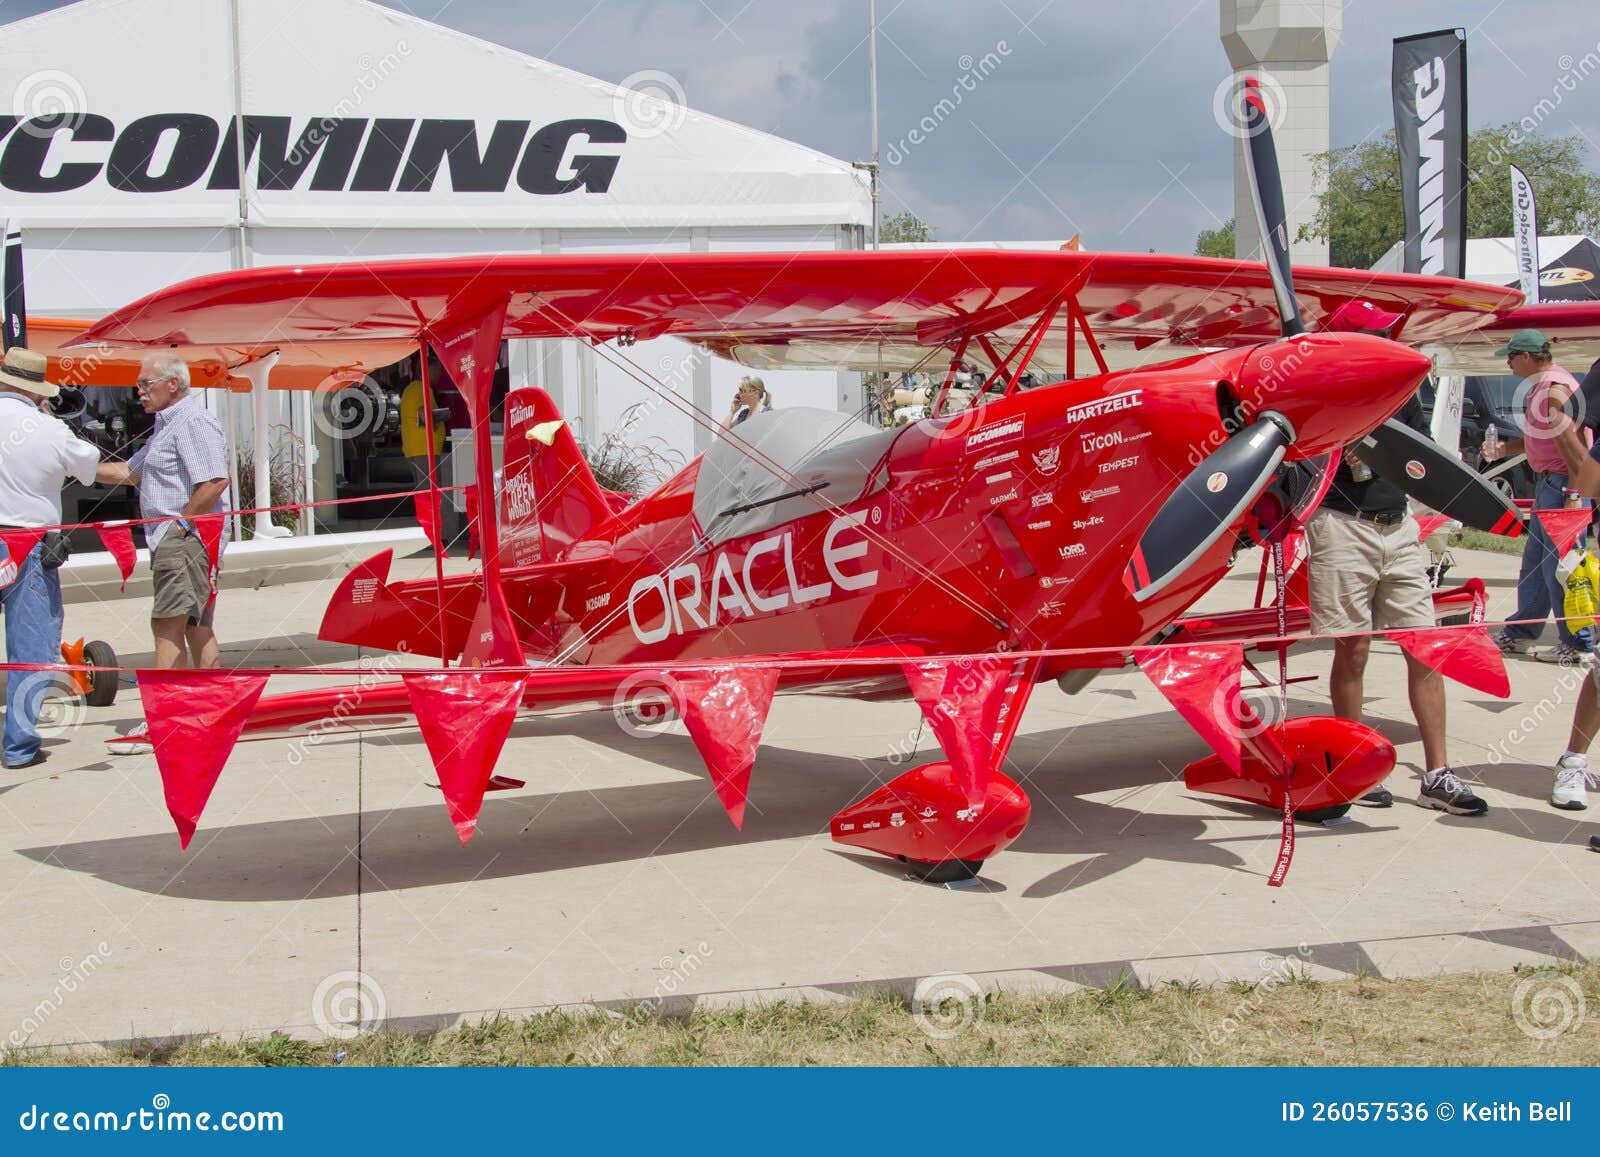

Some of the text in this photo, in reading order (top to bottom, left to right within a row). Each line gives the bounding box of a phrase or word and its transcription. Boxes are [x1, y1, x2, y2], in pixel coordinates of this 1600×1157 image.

[0, 113, 627, 195] COMING
[1067, 394, 1143, 424] HARTZELL
[967, 420, 1022, 446] LYCOMING
[1082, 431, 1123, 453] LYCON
[1098, 456, 1139, 473] TEMPEST
[990, 490, 1018, 505] GARMIN
[1059, 543, 1085, 556] LORD
[1282, 825, 1293, 855] BEFORE
